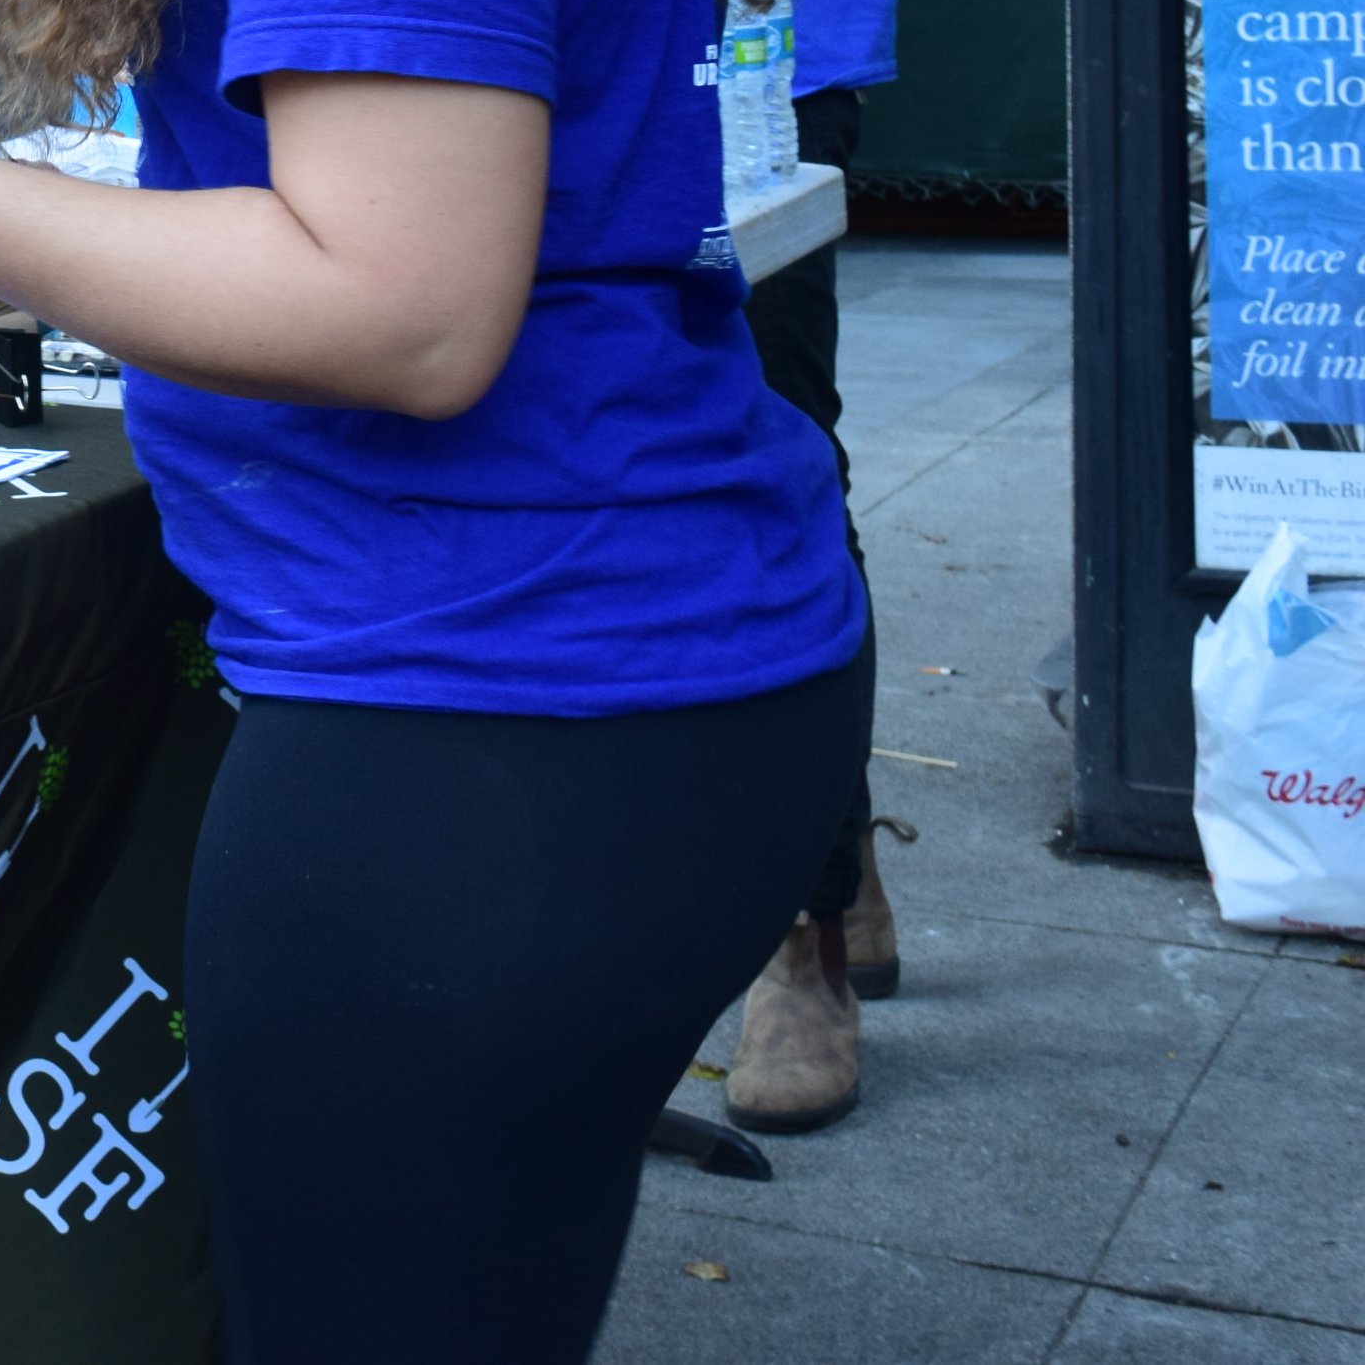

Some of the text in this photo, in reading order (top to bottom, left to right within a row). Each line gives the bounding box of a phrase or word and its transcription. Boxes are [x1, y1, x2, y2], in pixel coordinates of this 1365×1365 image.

[1240, 57, 1365, 107] is clo
[1241, 122, 1364, 172] than
[1240, 234, 1346, 274] Place
[1239, 287, 1343, 327] clean
[1232, 339, 1308, 388] foil
[54, 956, 169, 1076] I
